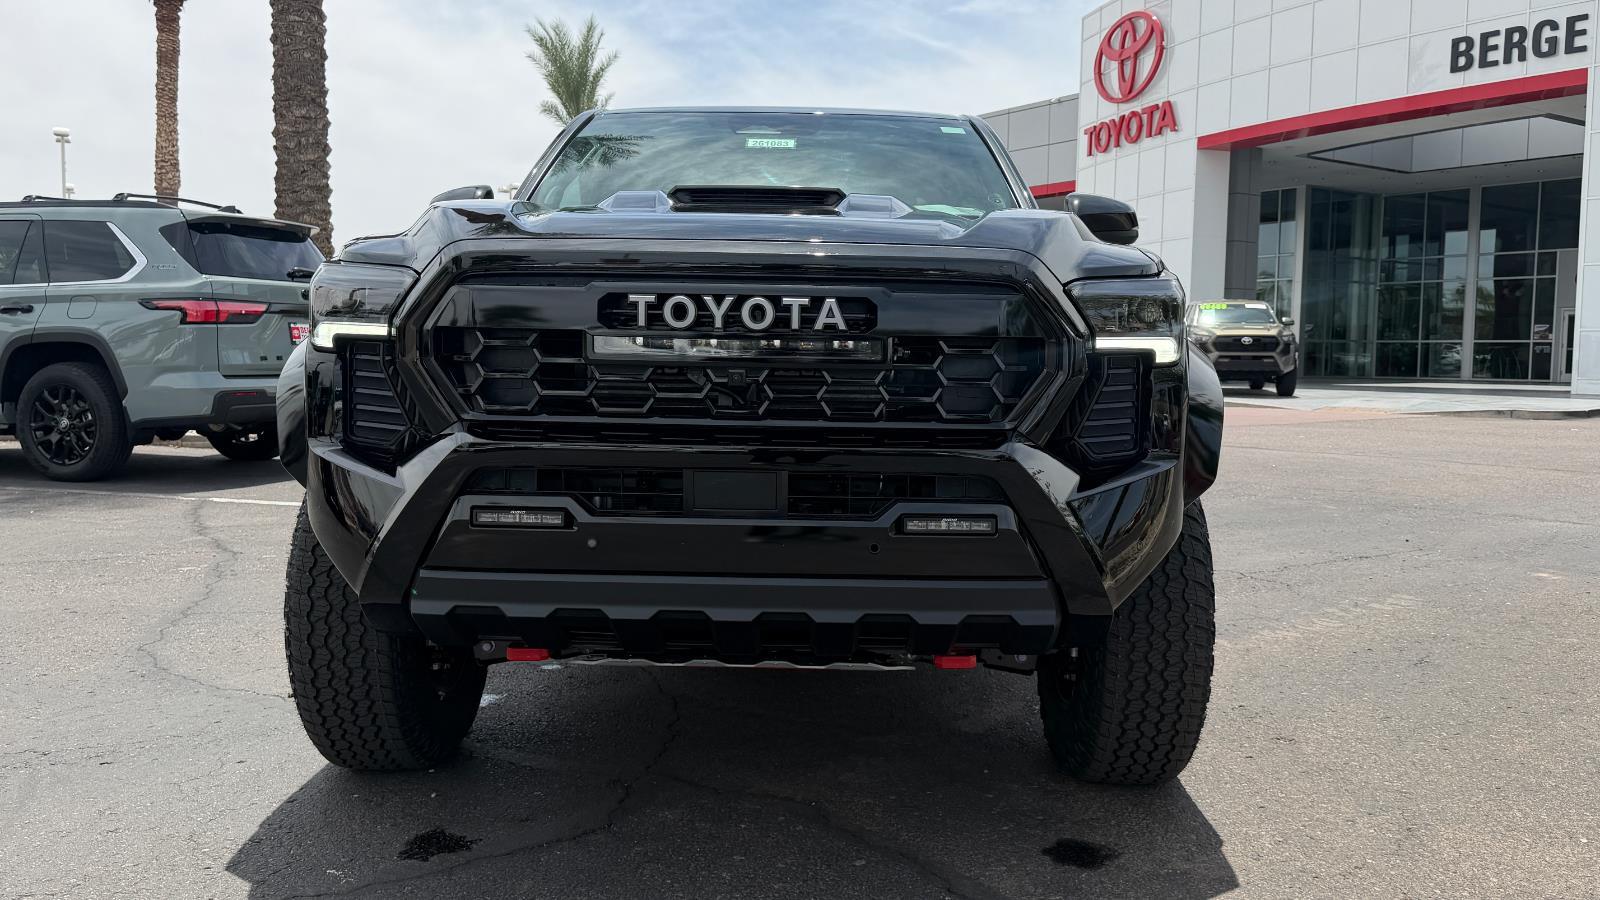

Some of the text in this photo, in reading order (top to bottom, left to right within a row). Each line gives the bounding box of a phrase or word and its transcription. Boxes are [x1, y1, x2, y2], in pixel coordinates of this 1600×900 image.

[1450, 13, 1589, 73] BERGE
[1084, 100, 1178, 156] TOYOTA
[628, 294, 847, 332] TOYOTA
